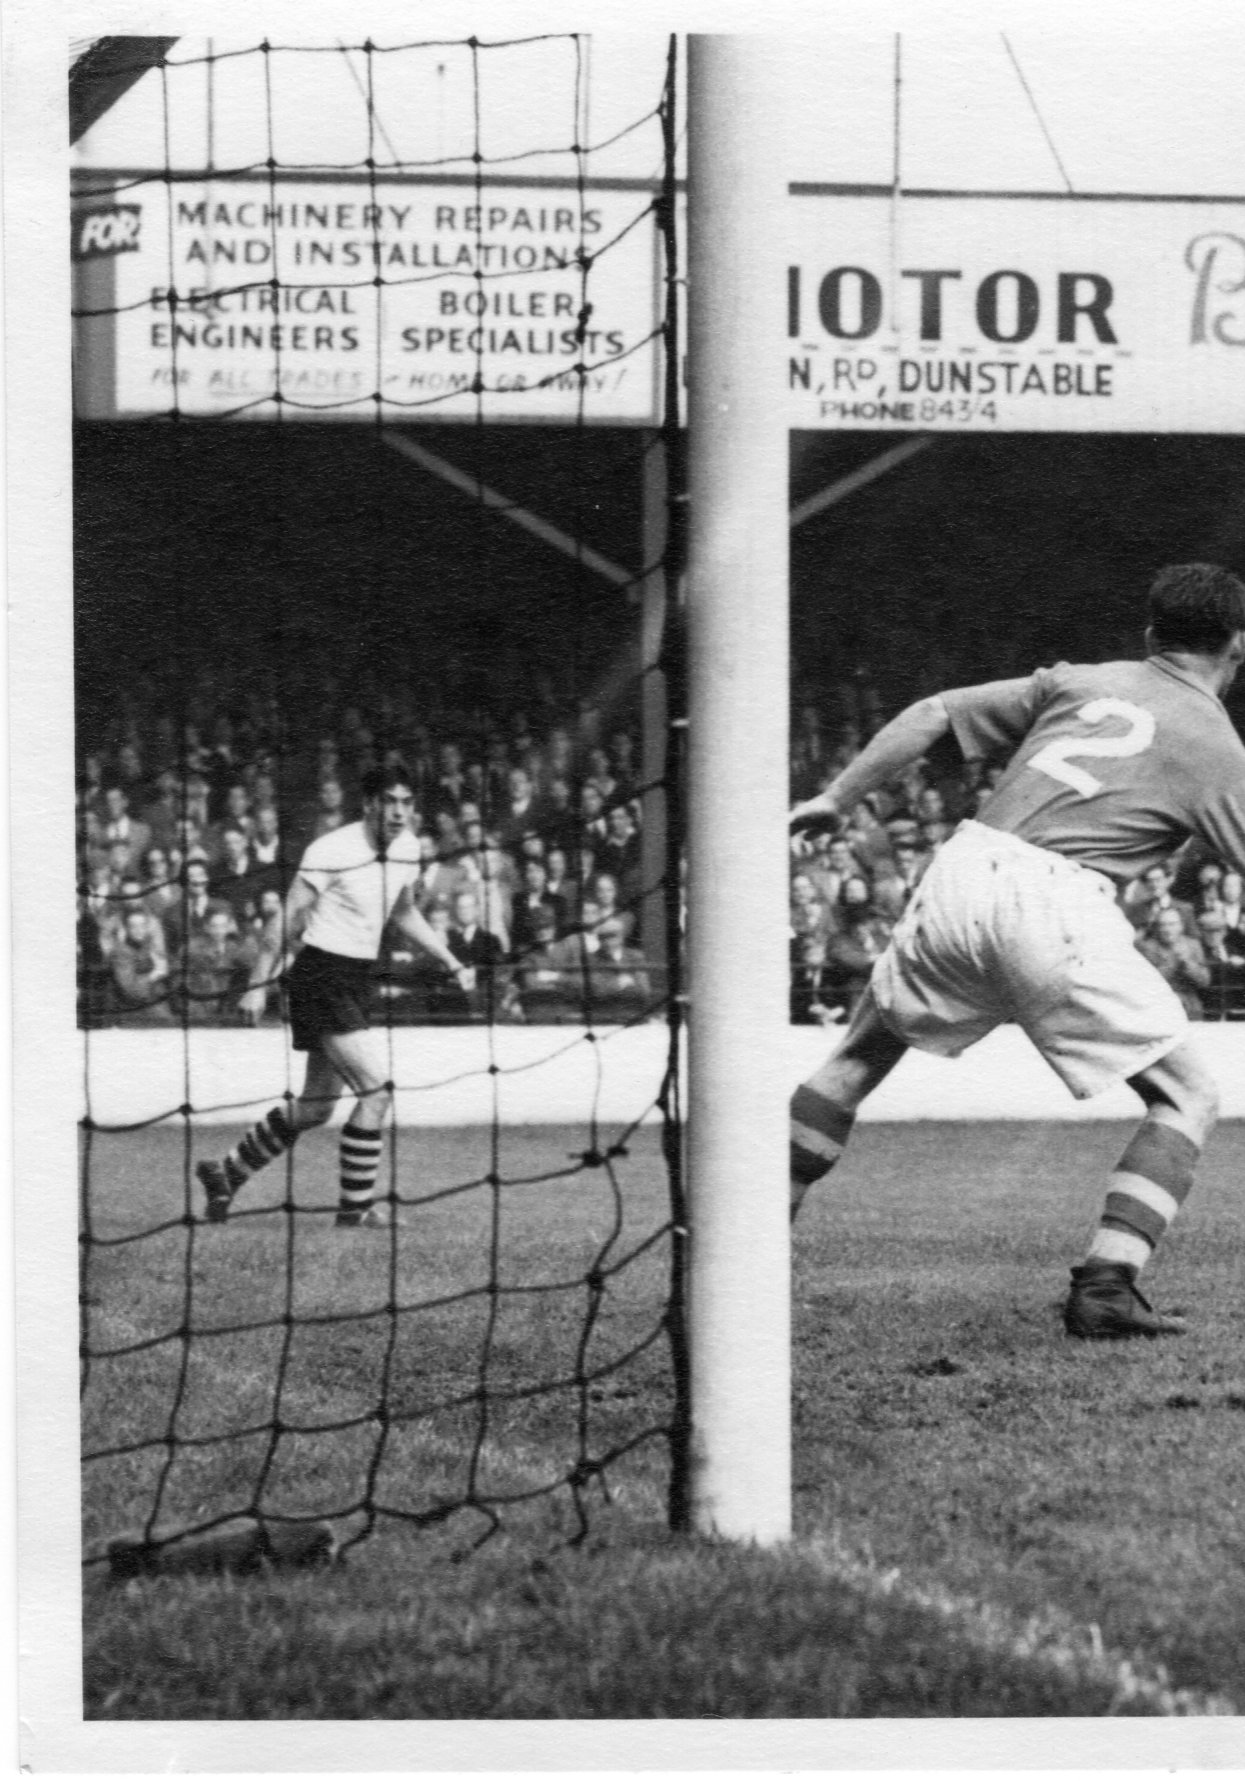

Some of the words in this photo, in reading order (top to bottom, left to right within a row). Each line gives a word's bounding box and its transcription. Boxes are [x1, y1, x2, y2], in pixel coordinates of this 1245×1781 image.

[80, 210, 139, 253] FOR
[177, 202, 411, 230] MACHINERY
[436, 204, 603, 234] REPAIRS
[186, 239, 271, 265] AND
[295, 241, 594, 272] INSTALLATIONS
[151, 286, 355, 314] ELECTRICAL
[440, 290, 575, 317] BOILER
[151, 323, 358, 351] ENGINEERS
[402, 327, 624, 355] SPECIALISTS
[409, 373, 484, 393] HOM
[899, 360, 1113, 397] DUNSTABLE
[820, 402, 915, 421] PHONE
[1026, 696, 1157, 799] 2
